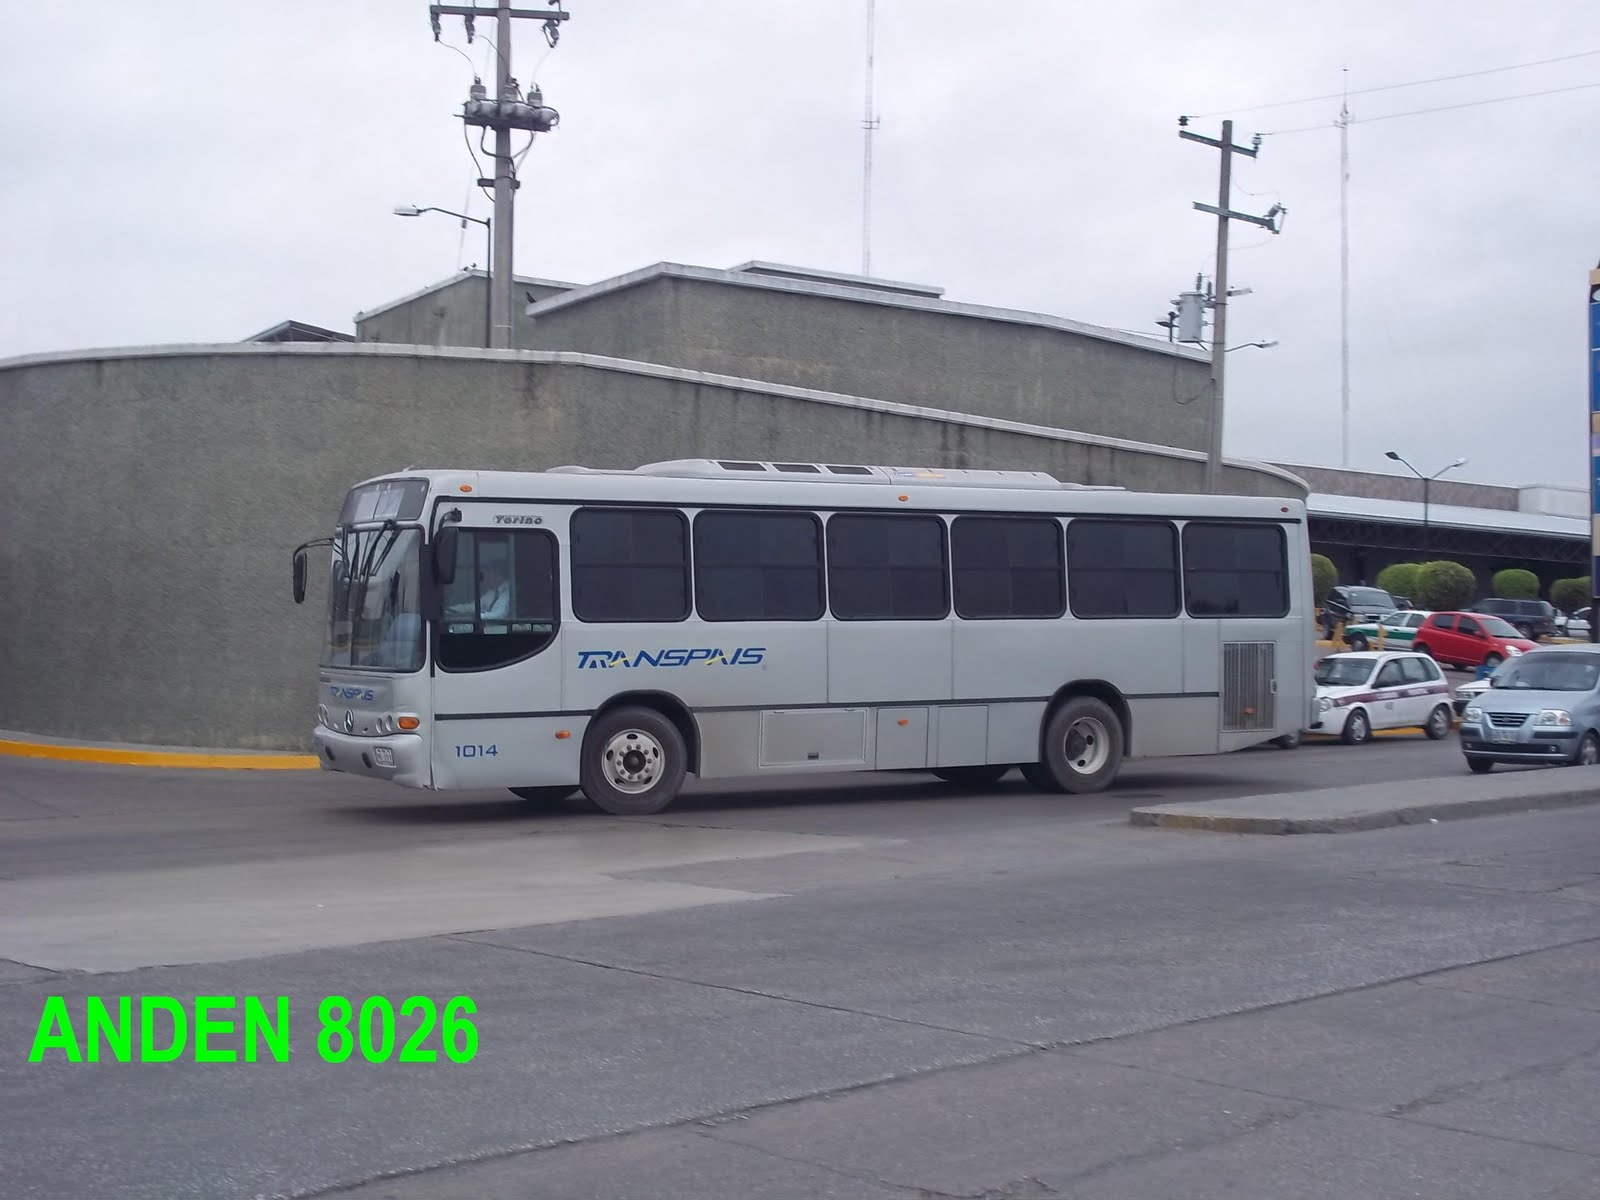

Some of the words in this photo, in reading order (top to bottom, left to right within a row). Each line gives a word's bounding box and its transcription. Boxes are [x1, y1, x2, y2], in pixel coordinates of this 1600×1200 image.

[495, 515, 543, 525] Torino
[577, 647, 767, 669] TRANSPAIS
[455, 744, 499, 758] 1014
